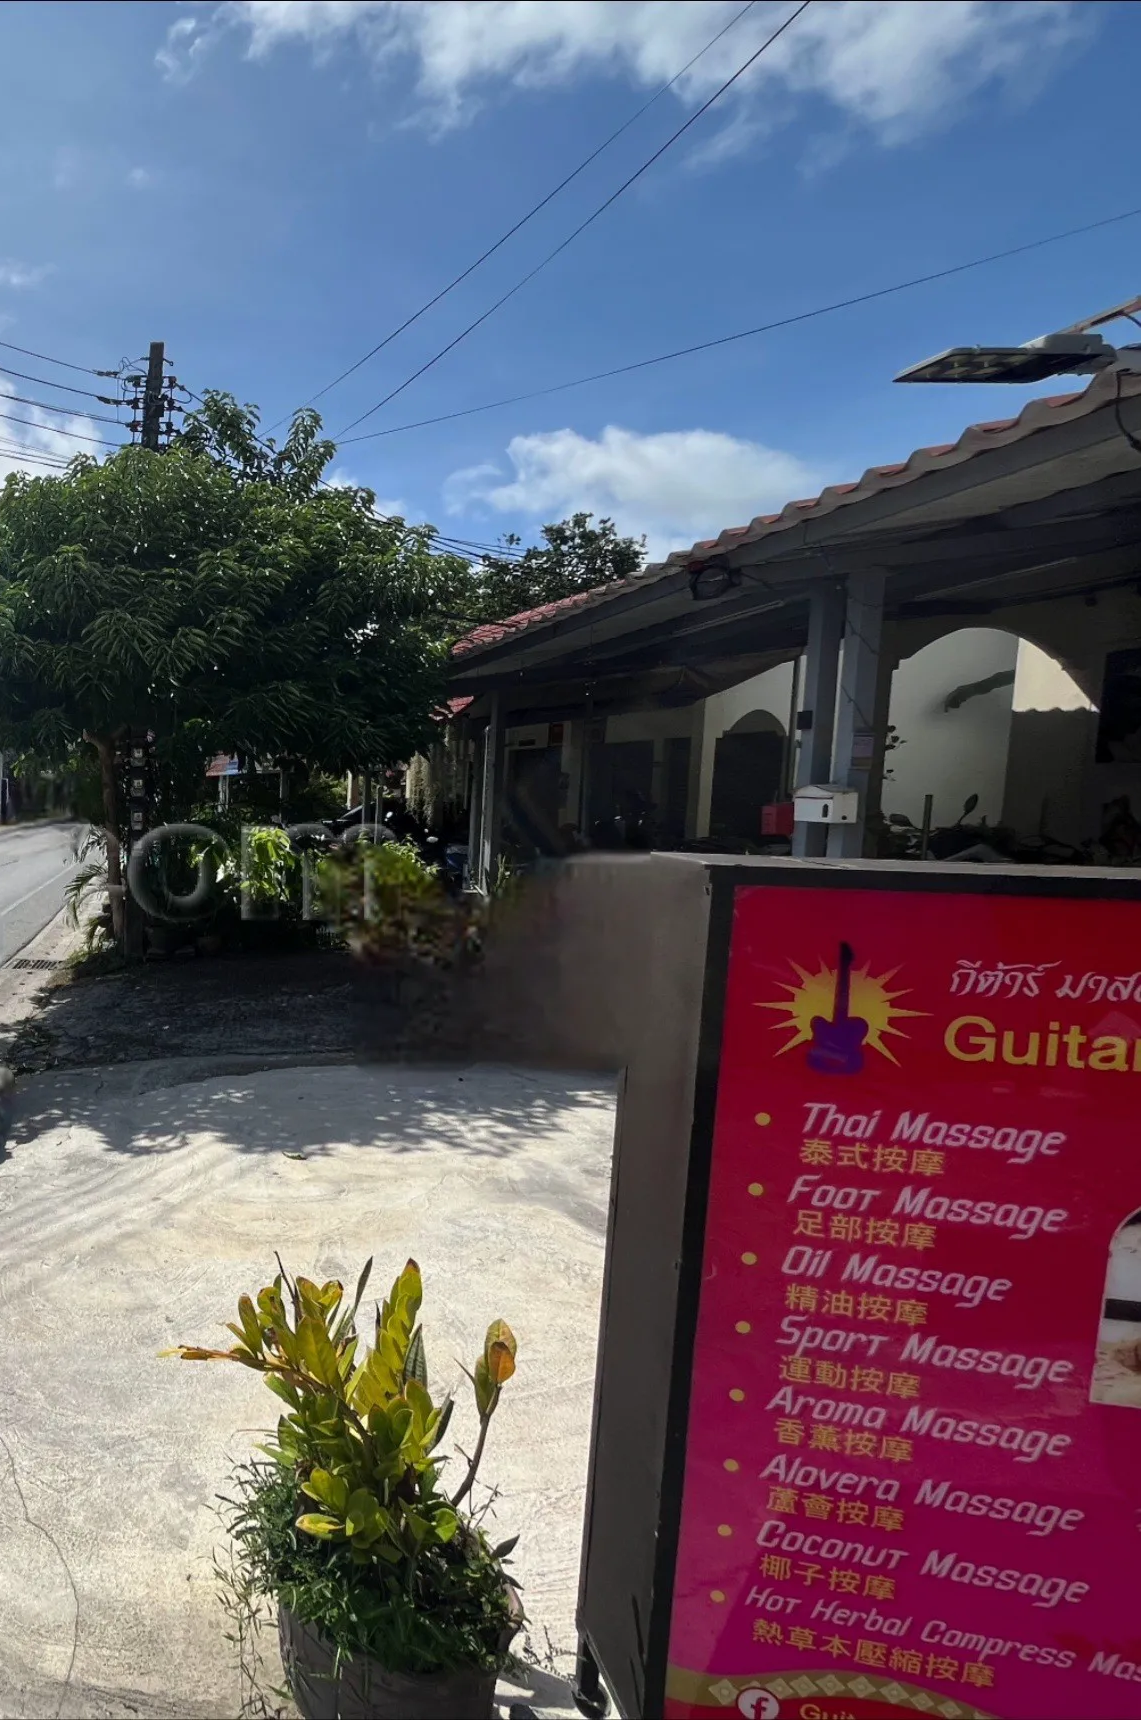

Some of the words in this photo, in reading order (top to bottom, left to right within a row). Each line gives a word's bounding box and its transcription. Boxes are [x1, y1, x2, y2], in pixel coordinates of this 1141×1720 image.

[799, 1138, 946, 1176] 泰式按摩
[802, 1102, 883, 1138] Thai
[890, 1110, 1067, 1164] Massage
[793, 1210, 937, 1250] 足部按摩
[892, 1186, 1069, 1240] Massage
[781, 1246, 833, 1278] Oil
[841, 1254, 1013, 1308] Massage
[784, 1282, 928, 1326] 精油按摩
[778, 1355, 921, 1399] 運動按摩
[900, 1332, 1074, 1389] Massage
[764, 1385, 887, 1430] Aroma
[900, 1405, 1072, 1462] Massage
[759, 1453, 901, 1502] Alovera
[913, 1479, 1085, 1536] Massage
[766, 1486, 905, 1532] 蘆薈按摩
[759, 1553, 897, 1602] 椰子按摩
[920, 1549, 1091, 1609] Massage
[752, 1618, 997, 1688] 熱草本壓縮按摩
[810, 1598, 913, 1638] Herbal
[920, 1620, 1077, 1670] Compress
